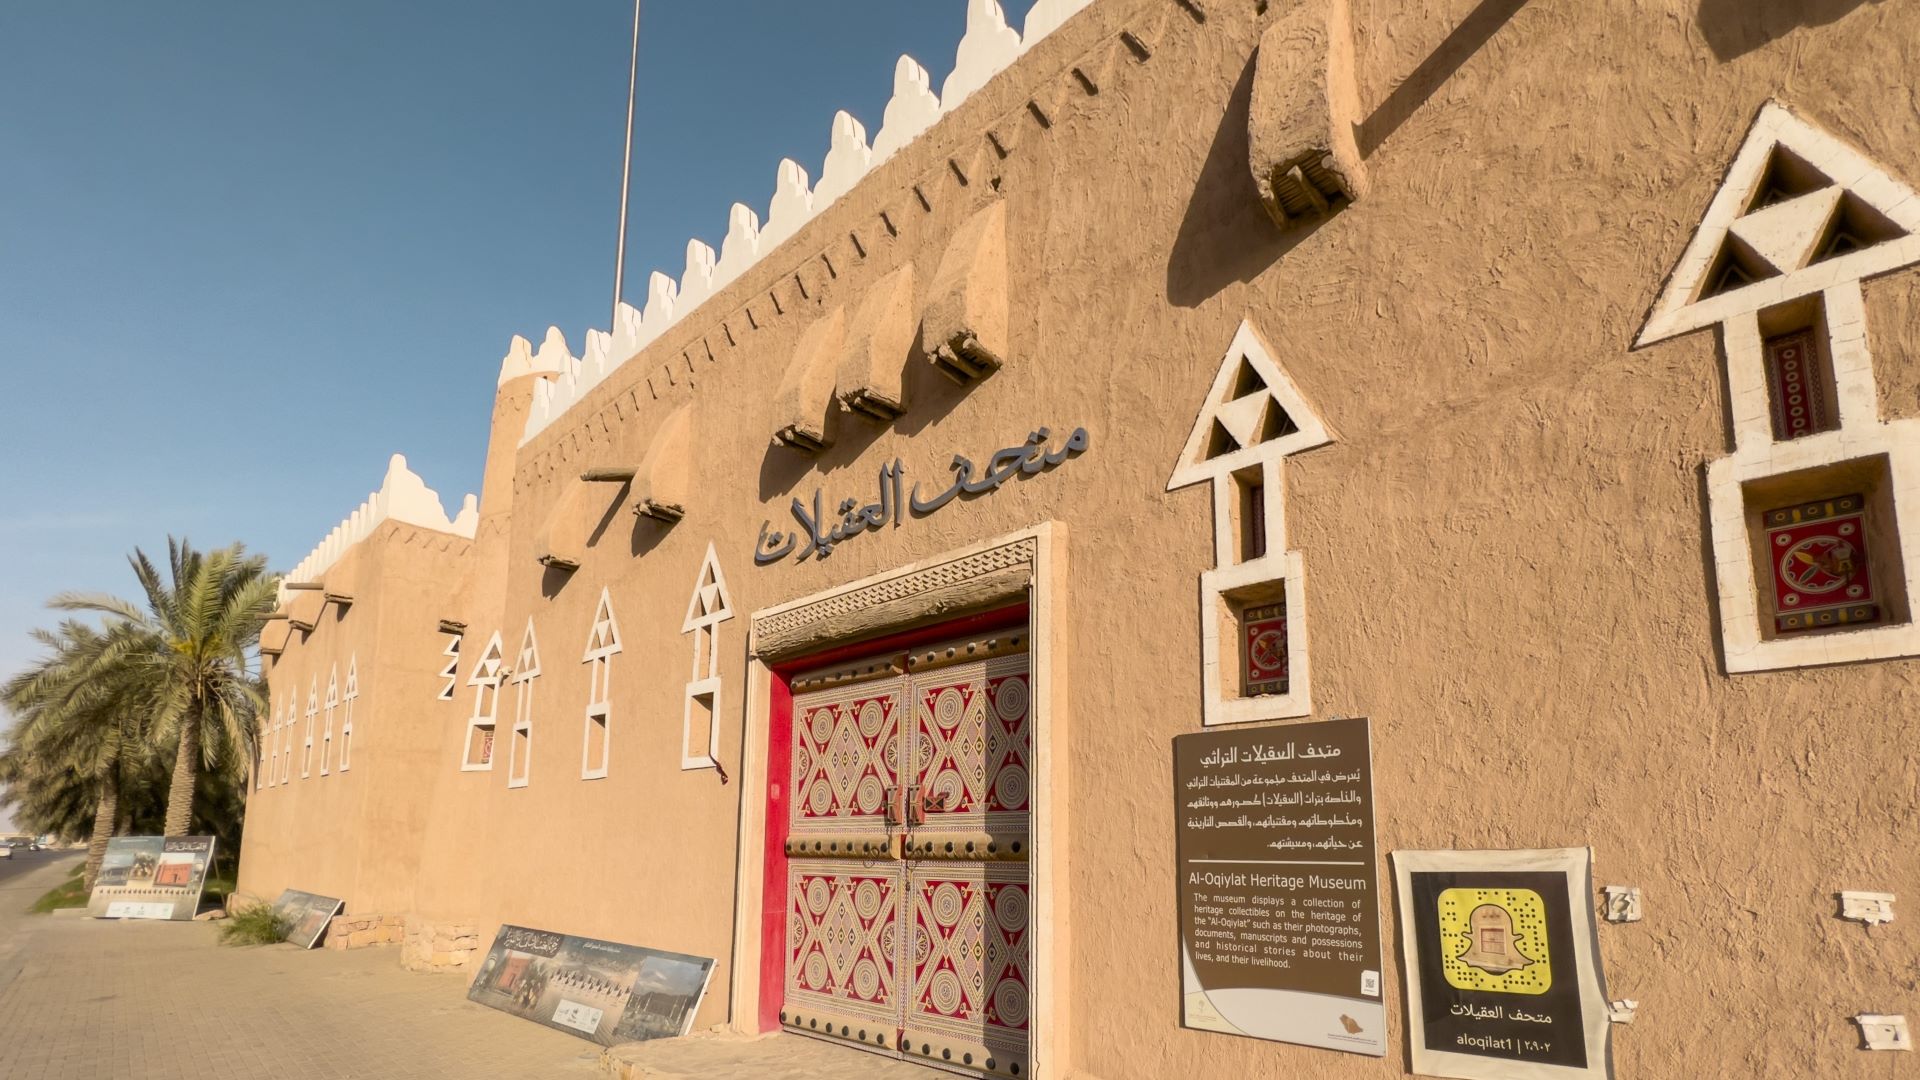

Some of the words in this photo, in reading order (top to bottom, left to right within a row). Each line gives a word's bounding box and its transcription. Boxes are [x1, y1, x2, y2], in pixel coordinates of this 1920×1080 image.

[910, 425, 1090, 513] متحف
[754, 457, 905, 566] العقيلات
[1200, 746, 1238, 768] التراثي
[1240, 742, 1295, 765] العقيلات
[1297, 743, 1342, 760] متحف
[1186, 776, 1208, 790] التراثي
[1209, 774, 1240, 787] المقتنيات
[1240, 777, 1252, 787] من
[1252, 774, 1286, 787] مجموعة
[1287, 770, 1317, 783] المتحف
[1318, 771, 1331, 784] في
[1187, 795, 1219, 809] ووثائقهم
[1219, 794, 1262, 808] كصورهم
[1304, 793, 1324, 806] بتراث
[1324, 790, 1362, 804] والخاصة
[1187, 815, 1214, 829] التاريخية
[1215, 814, 1252, 829] والقصص
[1298, 812, 1363, 828] ومخطوطاتهم
[1348, 839, 1363, 849] عن
[1188, 872, 1247, 887] Al-Oqiylat
[1250, 873, 1304, 891] Heritage
[1309, 875, 1367, 891] Museum
[1194, 893, 1208, 902] The
[1213, 895, 1246, 903] museum
[1251, 895, 1285, 906] displays
[1303, 898, 1345, 908] collection
[1351, 899, 1361, 909] of
[1194, 905, 1224, 916] heritage
[1228, 907, 1270, 917] collectibles
[1275, 909, 1286, 918] on
[1291, 909, 1305, 919] the
[1310, 911, 1346, 922] heritage
[1352, 912, 1362, 922] of
[1194, 916, 1207, 926] the
[1252, 919, 1271, 929] such
[1272, 922, 1282, 930] as
[1283, 921, 1303, 932] their
[1305, 923, 1362, 936] photographs,
[1194, 928, 1236, 940] documents,
[1240, 931, 1288, 944] manuscripts
[1291, 935, 1307, 945] and
[1311, 937, 1363, 949] possessions
[1195, 940, 1210, 949] and
[1216, 941, 1257, 953] historical
[1263, 945, 1296, 956] stories
[1303, 948, 1331, 960] about
[1338, 951, 1364, 962] their
[1195, 952, 1214, 961] lives,
[1216, 954, 1230, 963] and
[1231, 954, 1249, 964] their
[1251, 955, 1291, 969] livelihood.
[1450, 1004, 1503, 1020] العقيلات
[1508, 1008, 1553, 1024] متحف
[1456, 1033, 1512, 1050] aloqilat1
